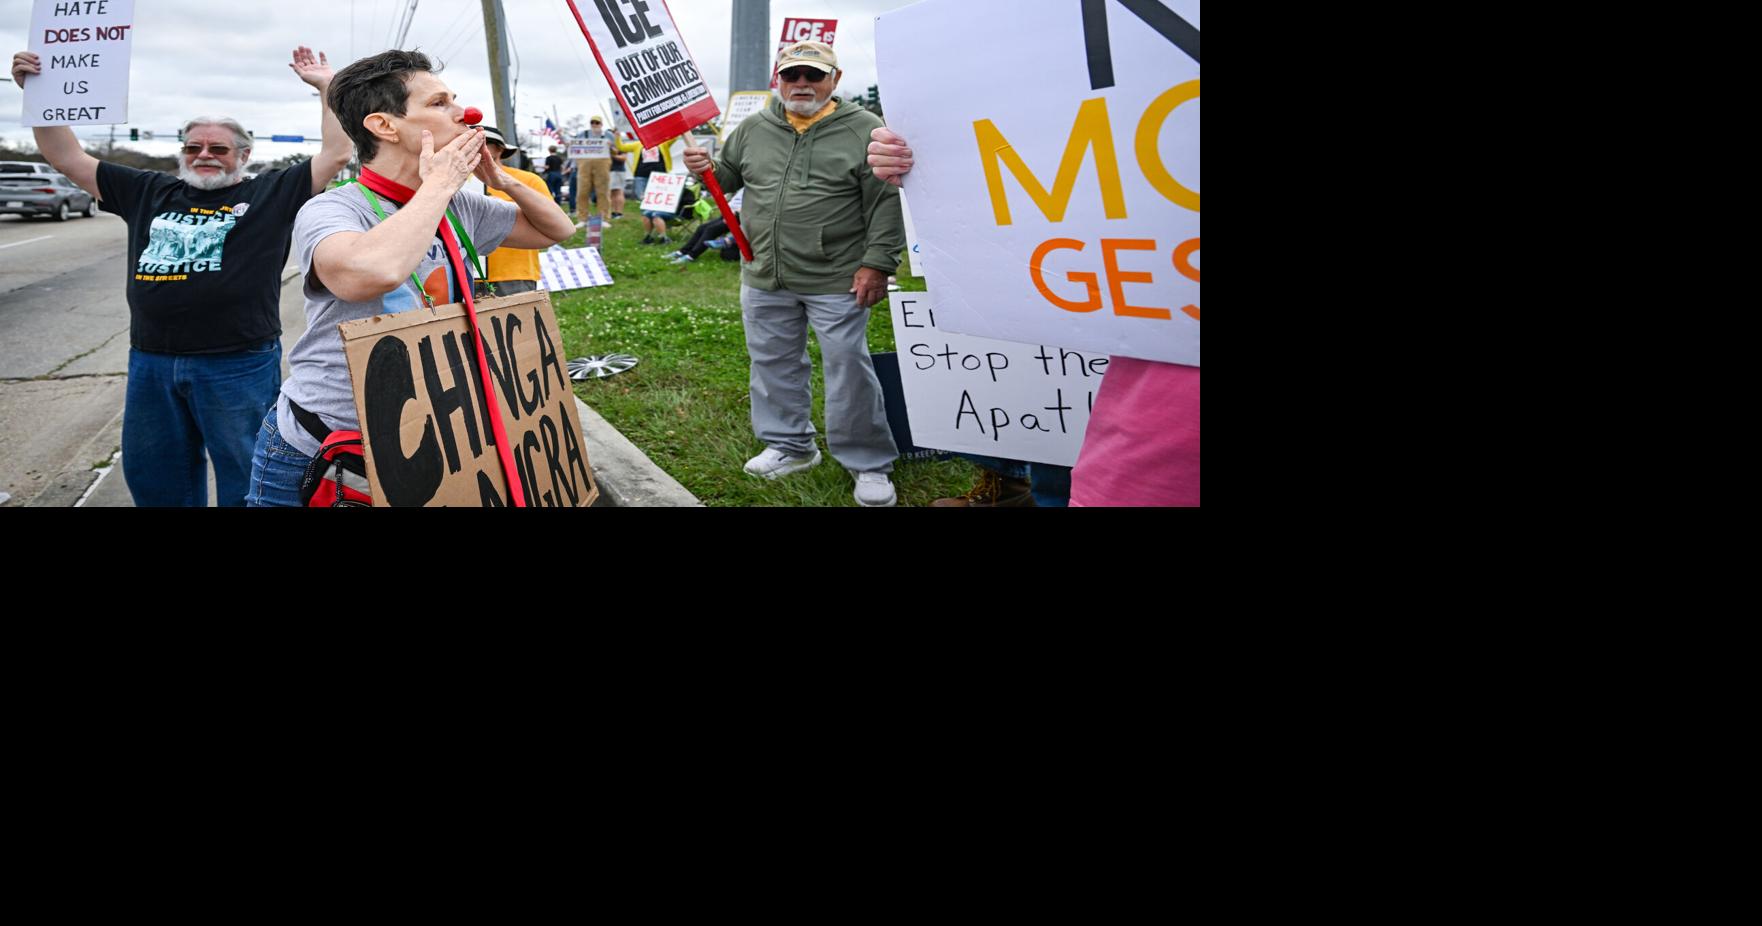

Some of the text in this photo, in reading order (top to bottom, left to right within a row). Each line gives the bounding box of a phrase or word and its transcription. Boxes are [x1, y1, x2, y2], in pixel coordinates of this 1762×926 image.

[54, 0, 108, 17] HATE
[594, 0, 664, 49] ICE
[786, 20, 824, 42] ICE
[44, 25, 131, 44] DOES NOT
[51, 54, 100, 69] MAKE
[615, 40, 683, 82] OUT OF OUR
[63, 80, 89, 95] US
[621, 59, 699, 108] COMMUNITIES
[42, 107, 106, 121] GREAT
[652, 175, 684, 185] MELT
[645, 192, 675, 205] ICE
[159, 211, 236, 225] JUSTICE
[137, 261, 222, 274] JUSTICE
[910, 343, 1110, 382] Stop the
